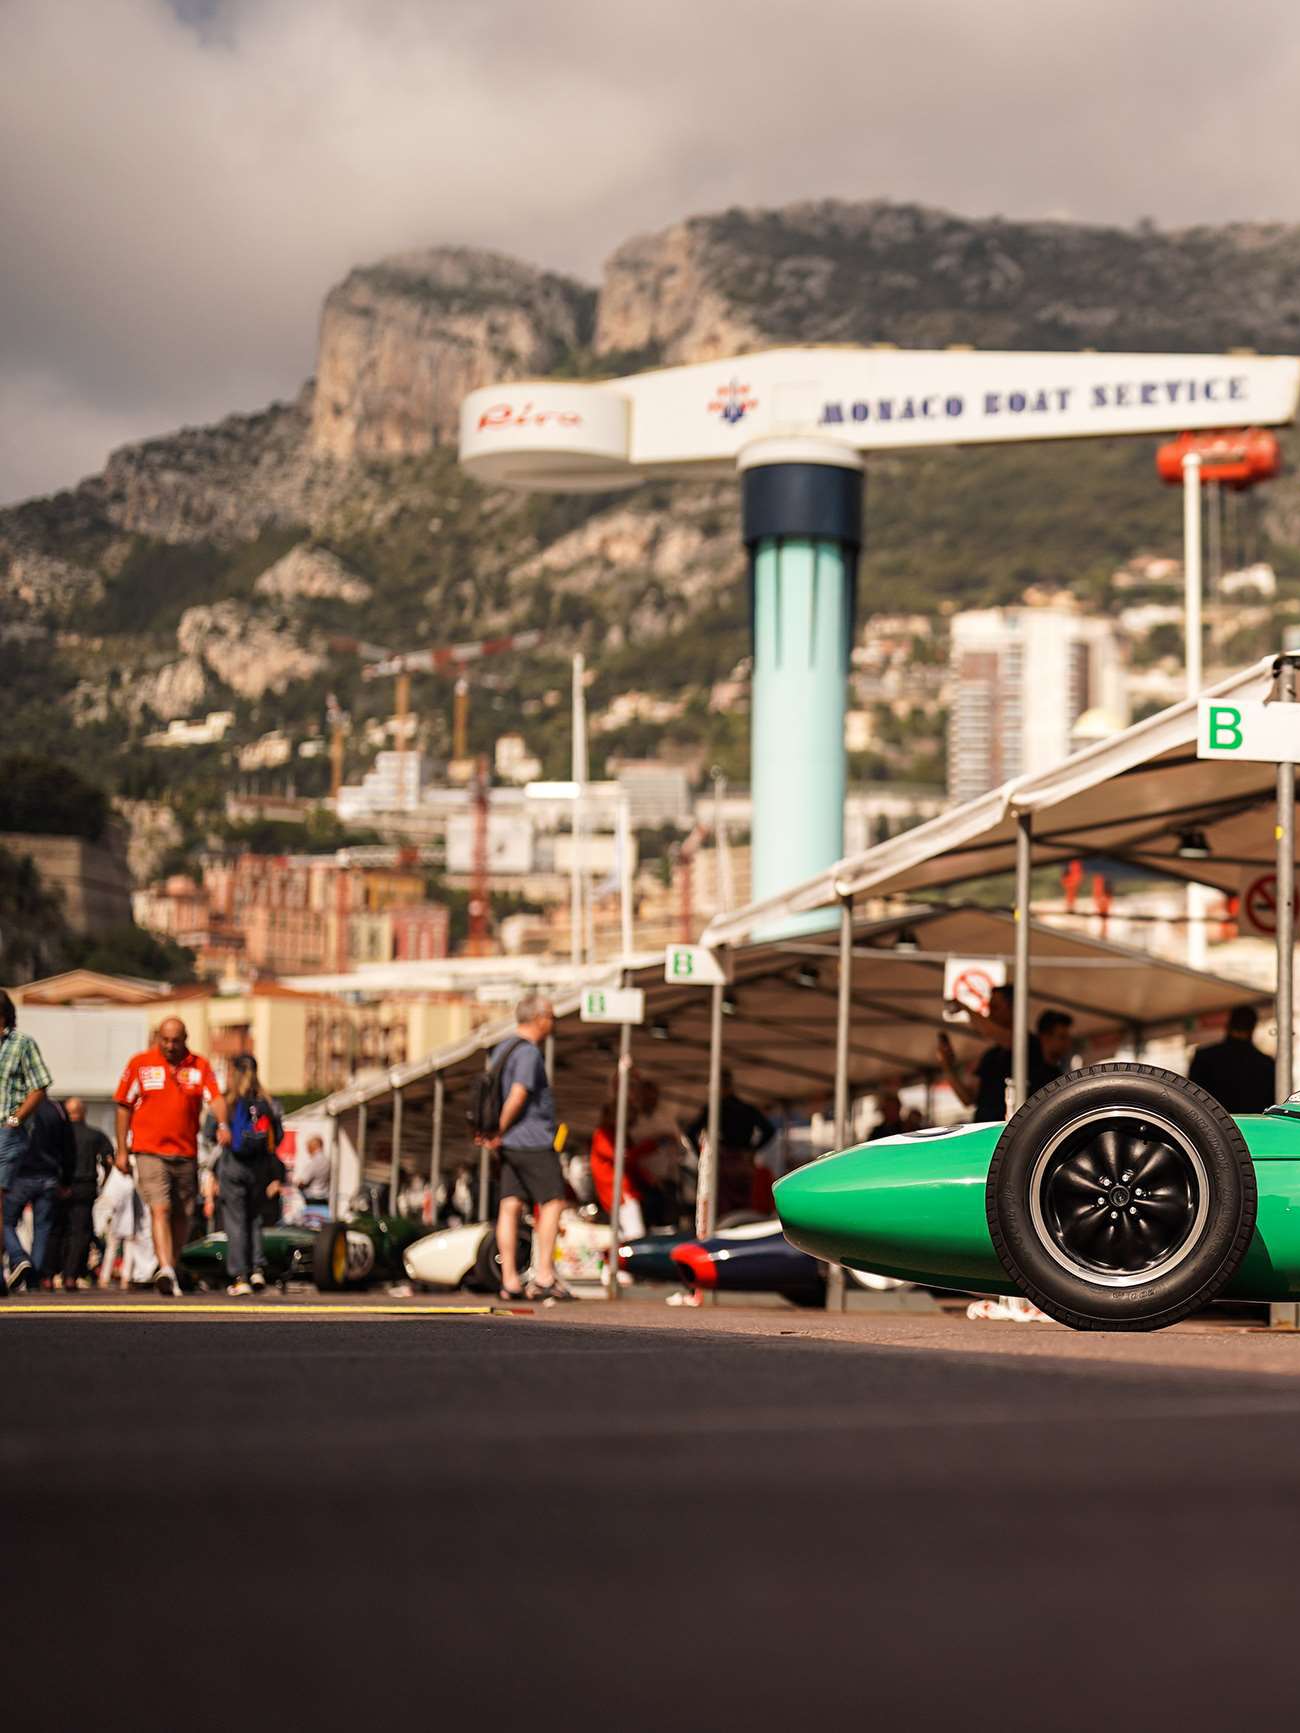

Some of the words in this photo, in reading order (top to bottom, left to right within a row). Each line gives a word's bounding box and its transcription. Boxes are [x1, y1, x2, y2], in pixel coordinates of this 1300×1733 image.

[818, 397, 963, 425] MONACO
[983, 386, 1073, 414] BOAT
[1091, 376, 1248, 407] SERVICE
[1209, 706, 1243, 750] B
[674, 952, 693, 976] B
